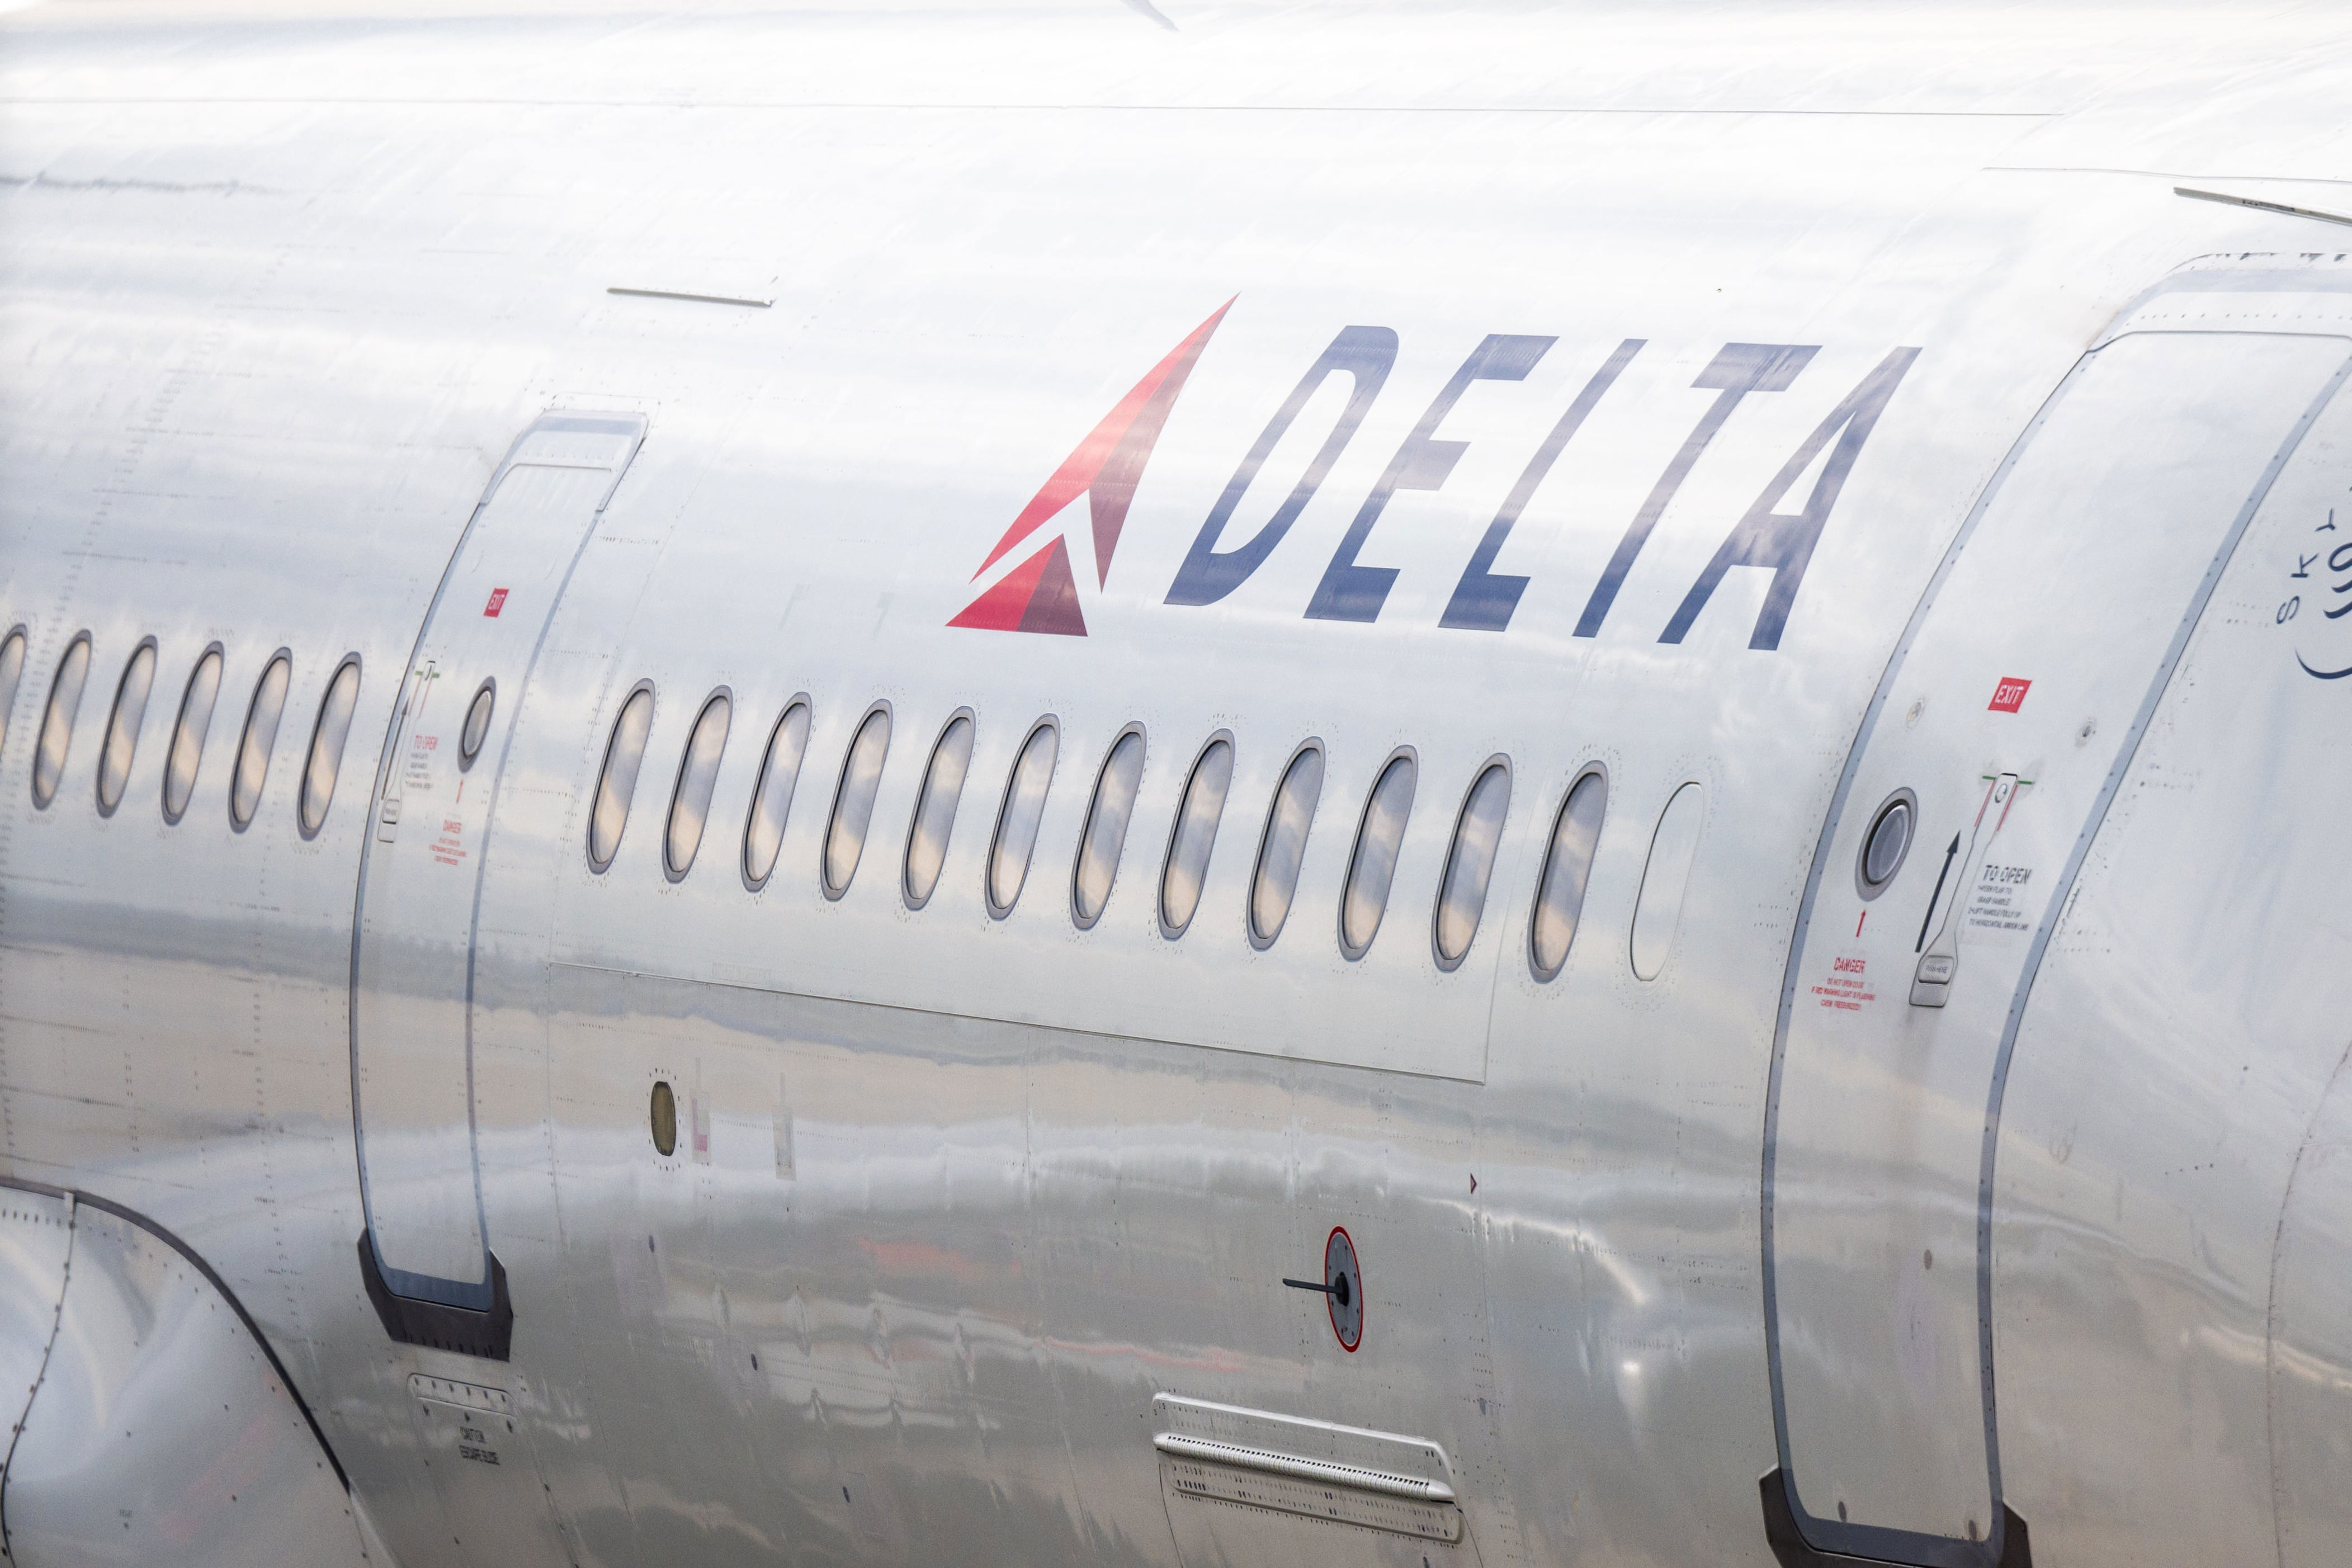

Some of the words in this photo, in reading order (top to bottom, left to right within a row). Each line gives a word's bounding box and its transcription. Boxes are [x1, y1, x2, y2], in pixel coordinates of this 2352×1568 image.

[1163, 326, 1923, 651] DELTA
[2277, 485, 2352, 625] SKY
[488, 594, 505, 610] EXIT
[1995, 684, 2024, 705] EXIT
[1983, 865, 1999, 881] TO
[2000, 866, 2032, 884] OPEN
[1834, 957, 1866, 973] DANGER
